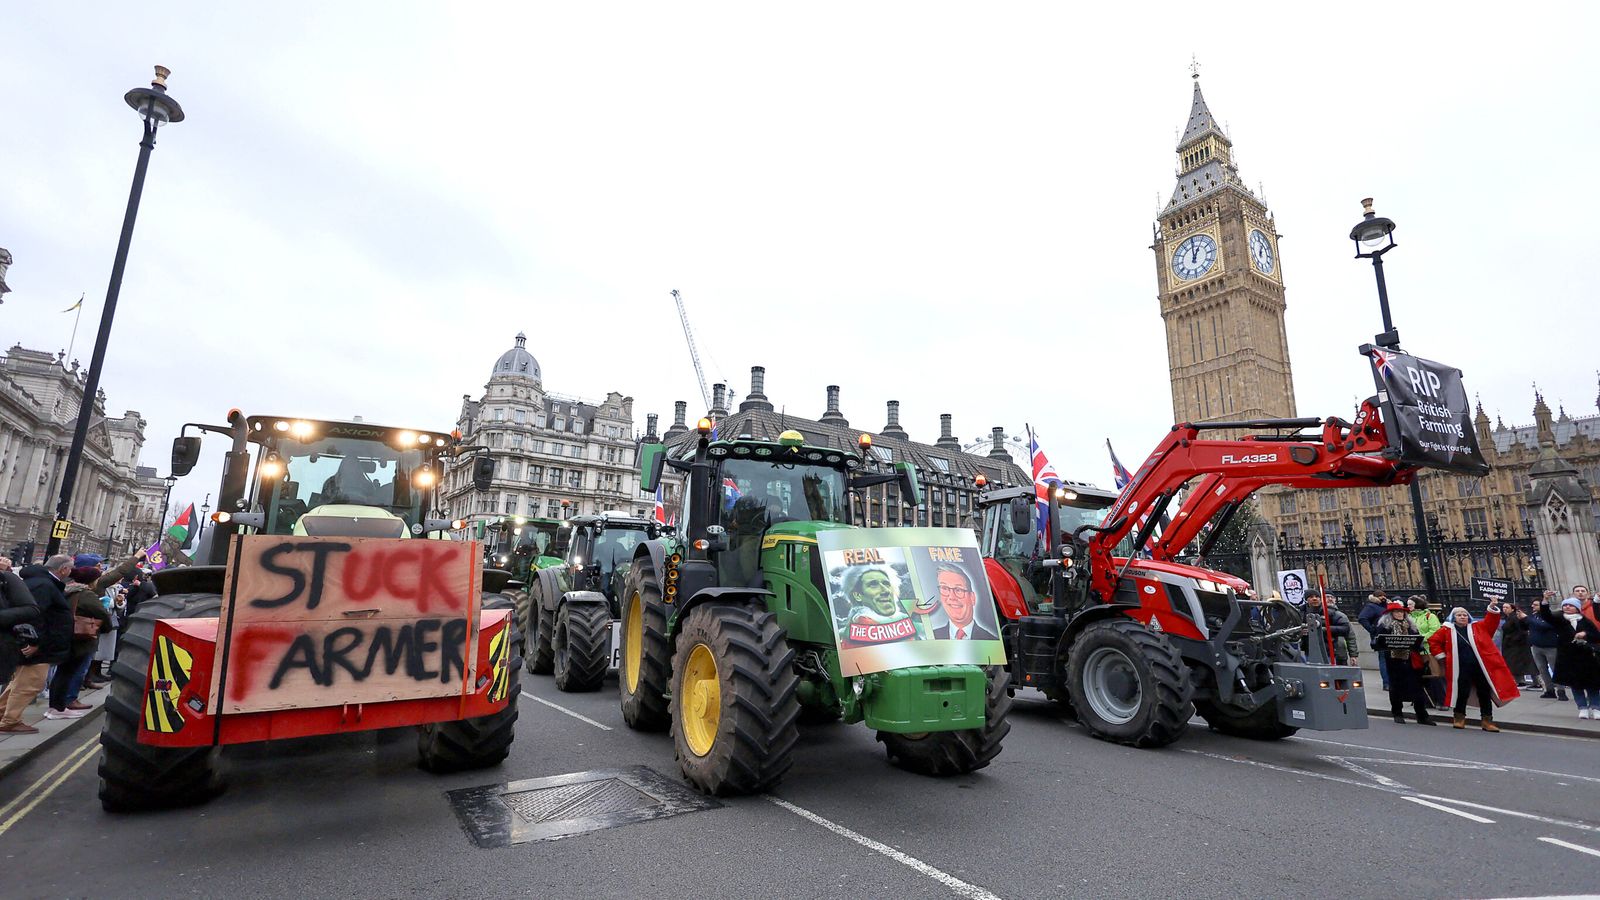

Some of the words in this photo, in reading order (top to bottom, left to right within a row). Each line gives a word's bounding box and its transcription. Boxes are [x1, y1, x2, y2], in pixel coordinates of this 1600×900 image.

[1407, 366, 1440, 398] RIP
[1417, 399, 1452, 418] British
[328, 427, 385, 438] AXION
[1418, 415, 1464, 438] Farming
[1221, 453, 1277, 464] FL.4323
[55, 522, 69, 537] H
[843, 548, 885, 566] REAL
[928, 546, 963, 562] FAKE
[251, 542, 462, 613] STUCK
[1480, 586, 1507, 595] FARMERS
[851, 624, 866, 638] THE
[867, 619, 913, 641] GRINCH
[230, 617, 470, 702] FARMER
